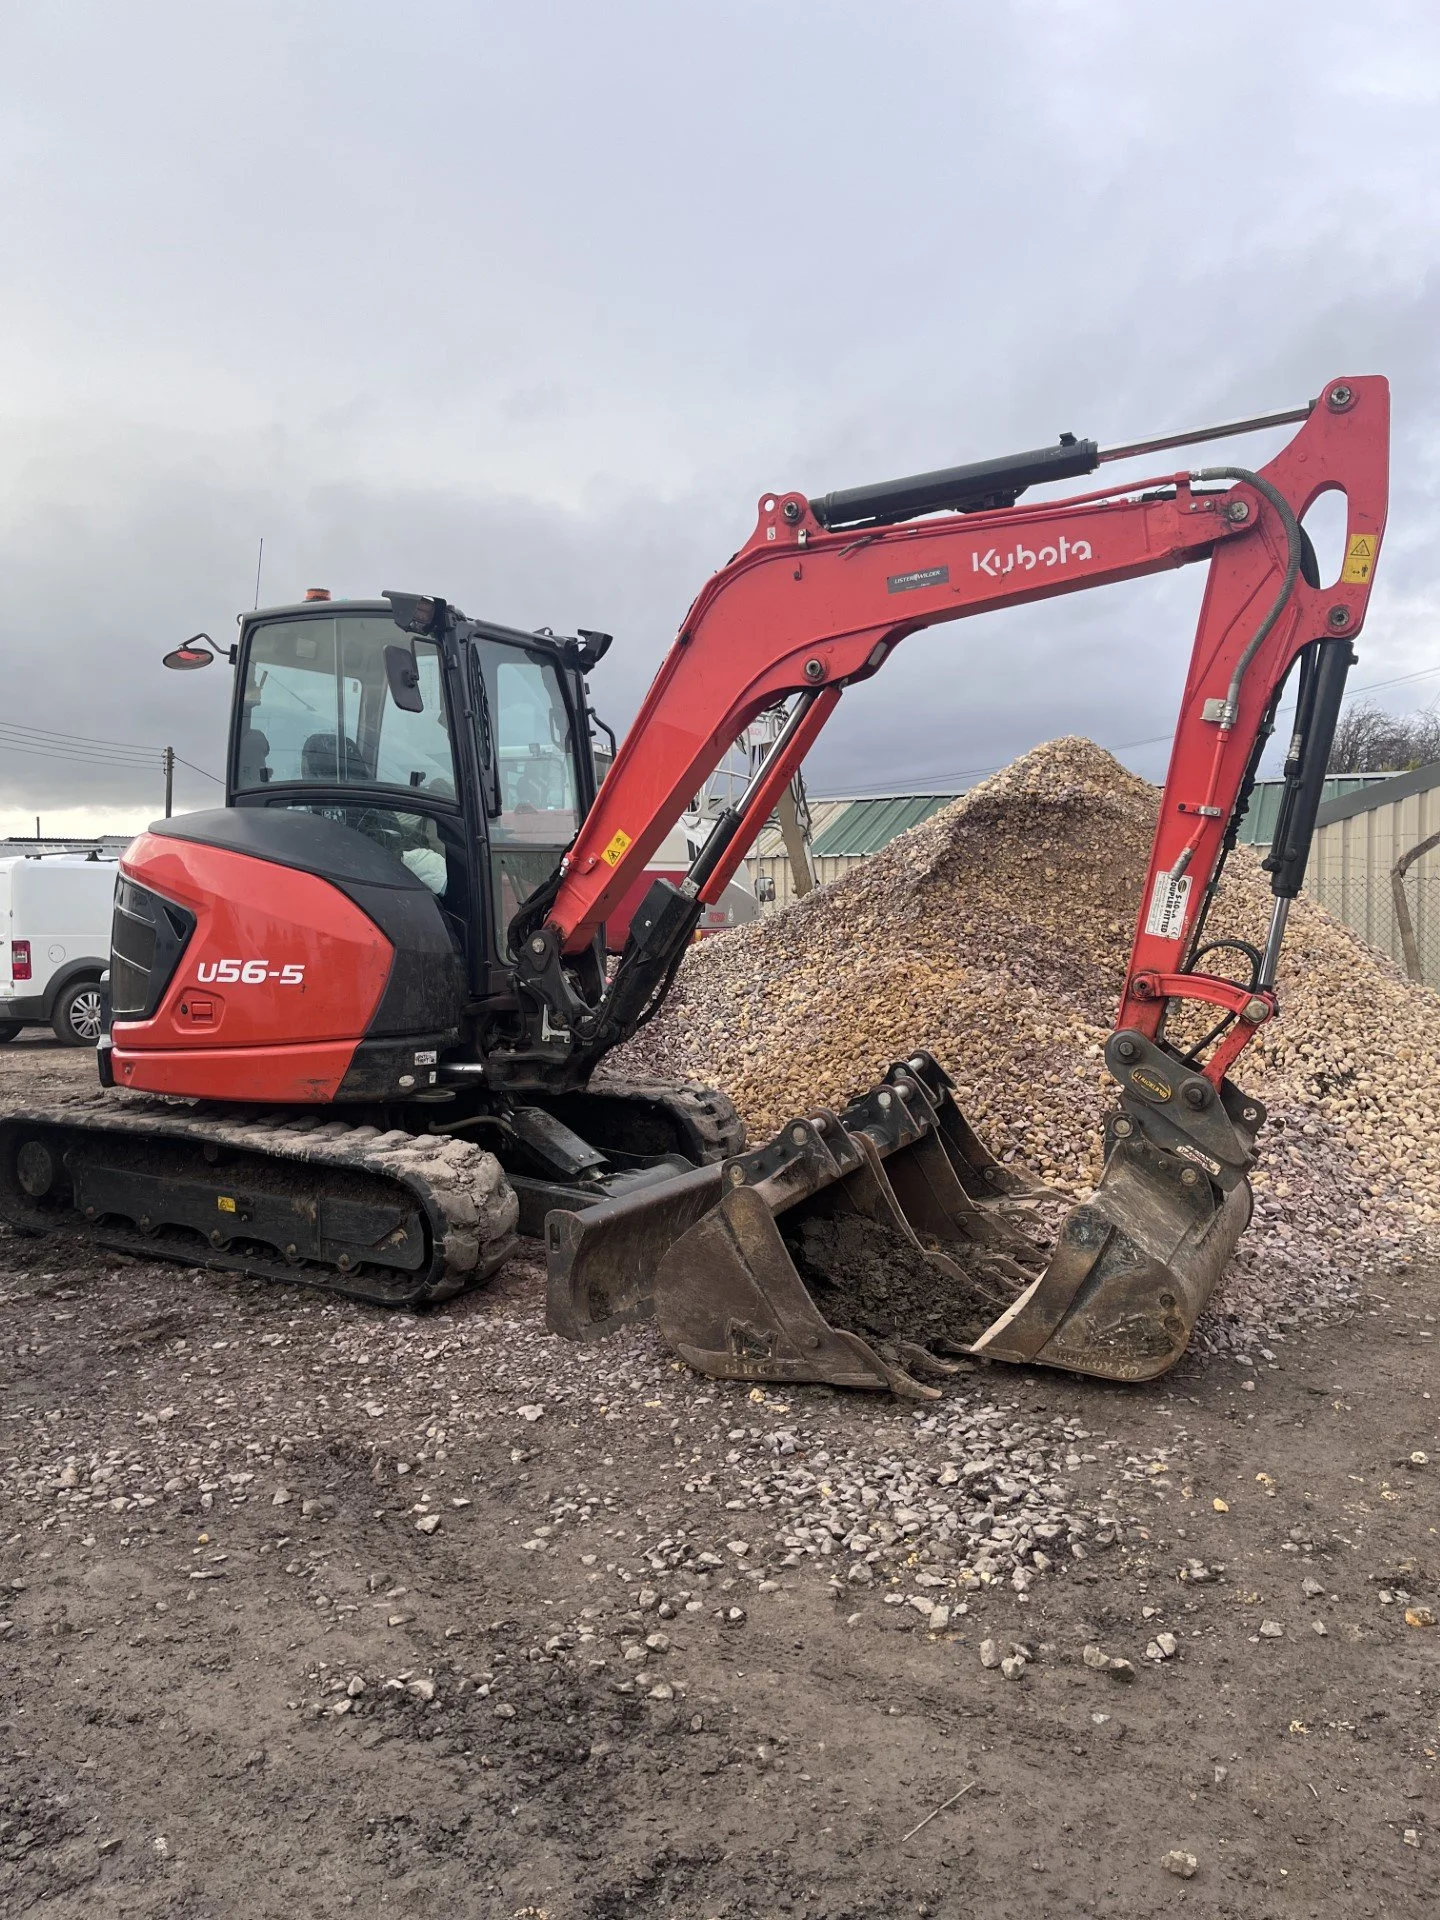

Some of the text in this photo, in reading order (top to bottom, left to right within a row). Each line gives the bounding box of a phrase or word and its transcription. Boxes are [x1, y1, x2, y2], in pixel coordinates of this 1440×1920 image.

[972, 536, 1092, 577] Kubota
[1161, 909, 1171, 933] FITTED
[197, 959, 306, 985] U56-5
